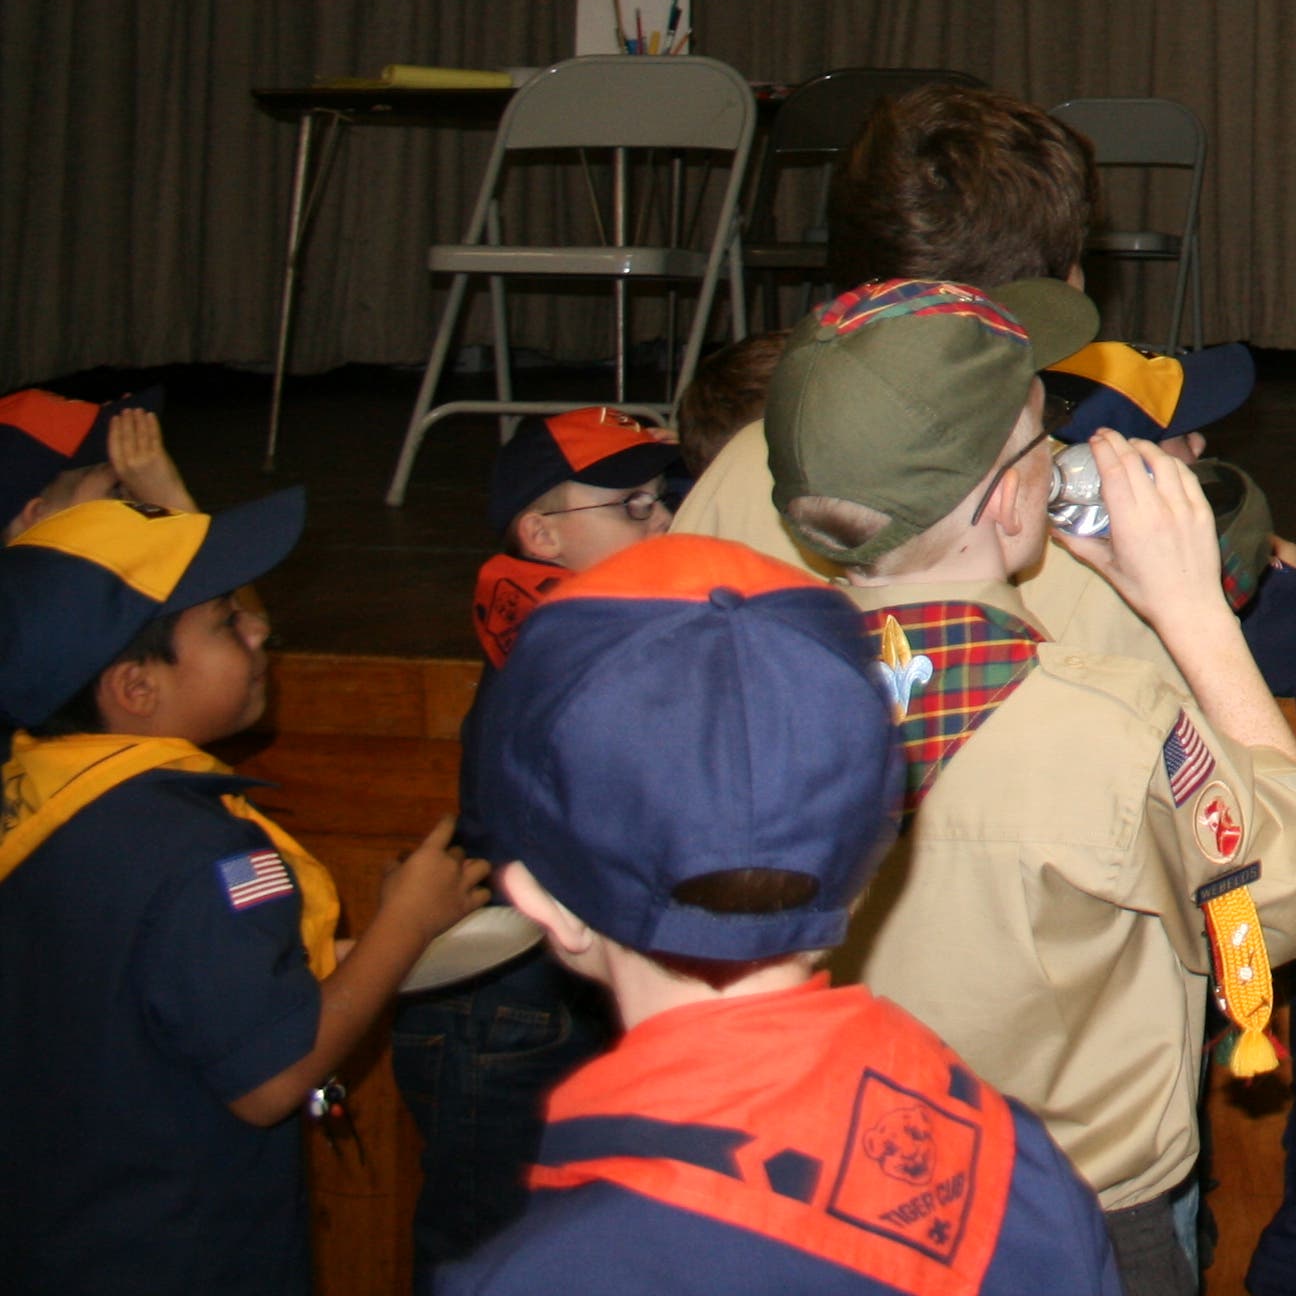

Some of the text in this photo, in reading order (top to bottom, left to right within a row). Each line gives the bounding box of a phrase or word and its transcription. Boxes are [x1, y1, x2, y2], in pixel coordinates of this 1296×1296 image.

[1200, 868, 1258, 899] WEBELOS
[880, 1171, 966, 1228] TIGER CUB
